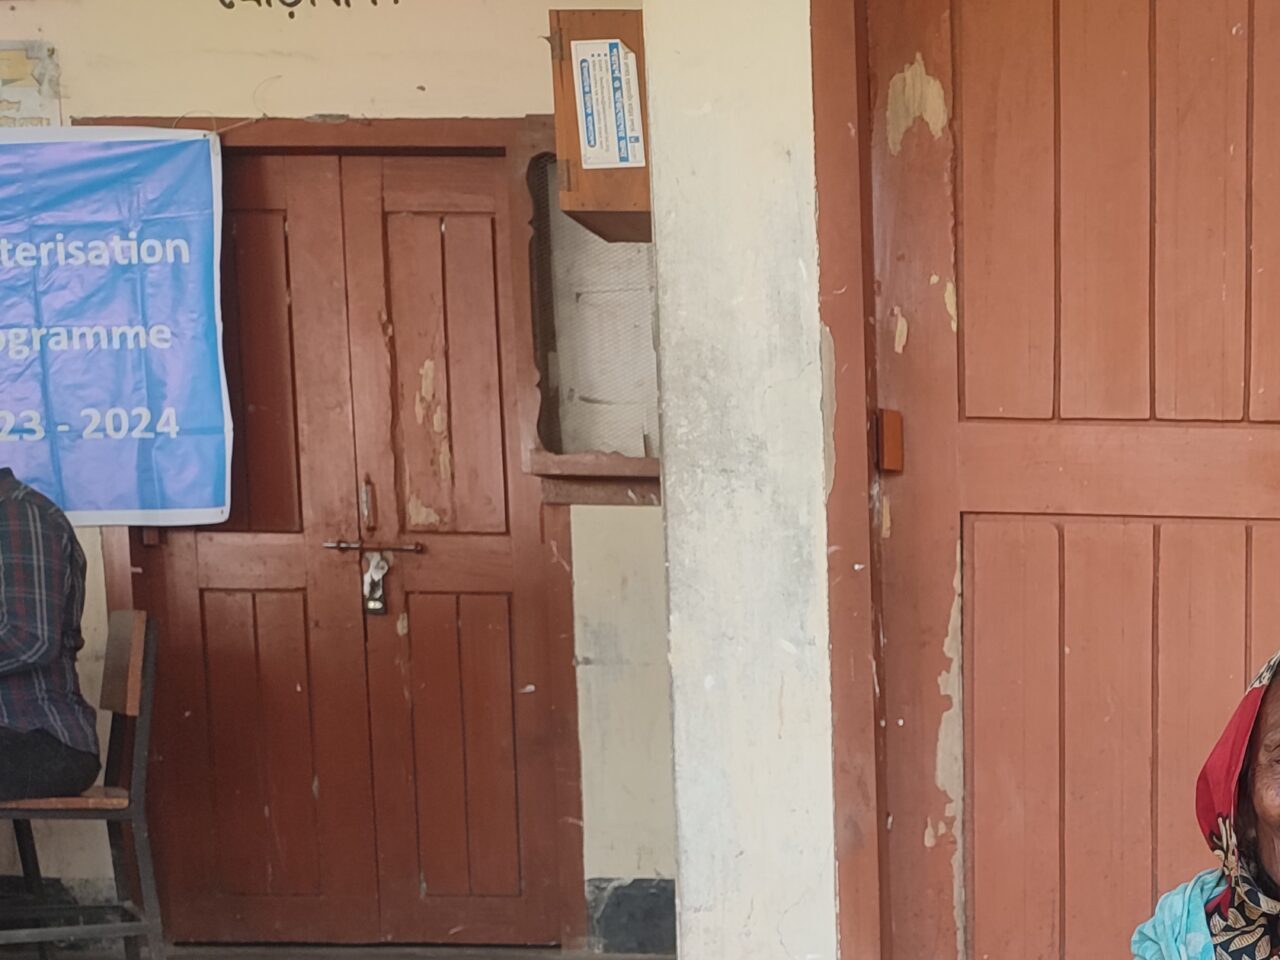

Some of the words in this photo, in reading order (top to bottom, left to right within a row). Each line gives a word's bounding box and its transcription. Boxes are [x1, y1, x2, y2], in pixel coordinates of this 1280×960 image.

[0, 231, 190, 267] terisation
[0, 323, 172, 360] gramme
[80, 407, 180, 439] 2024
